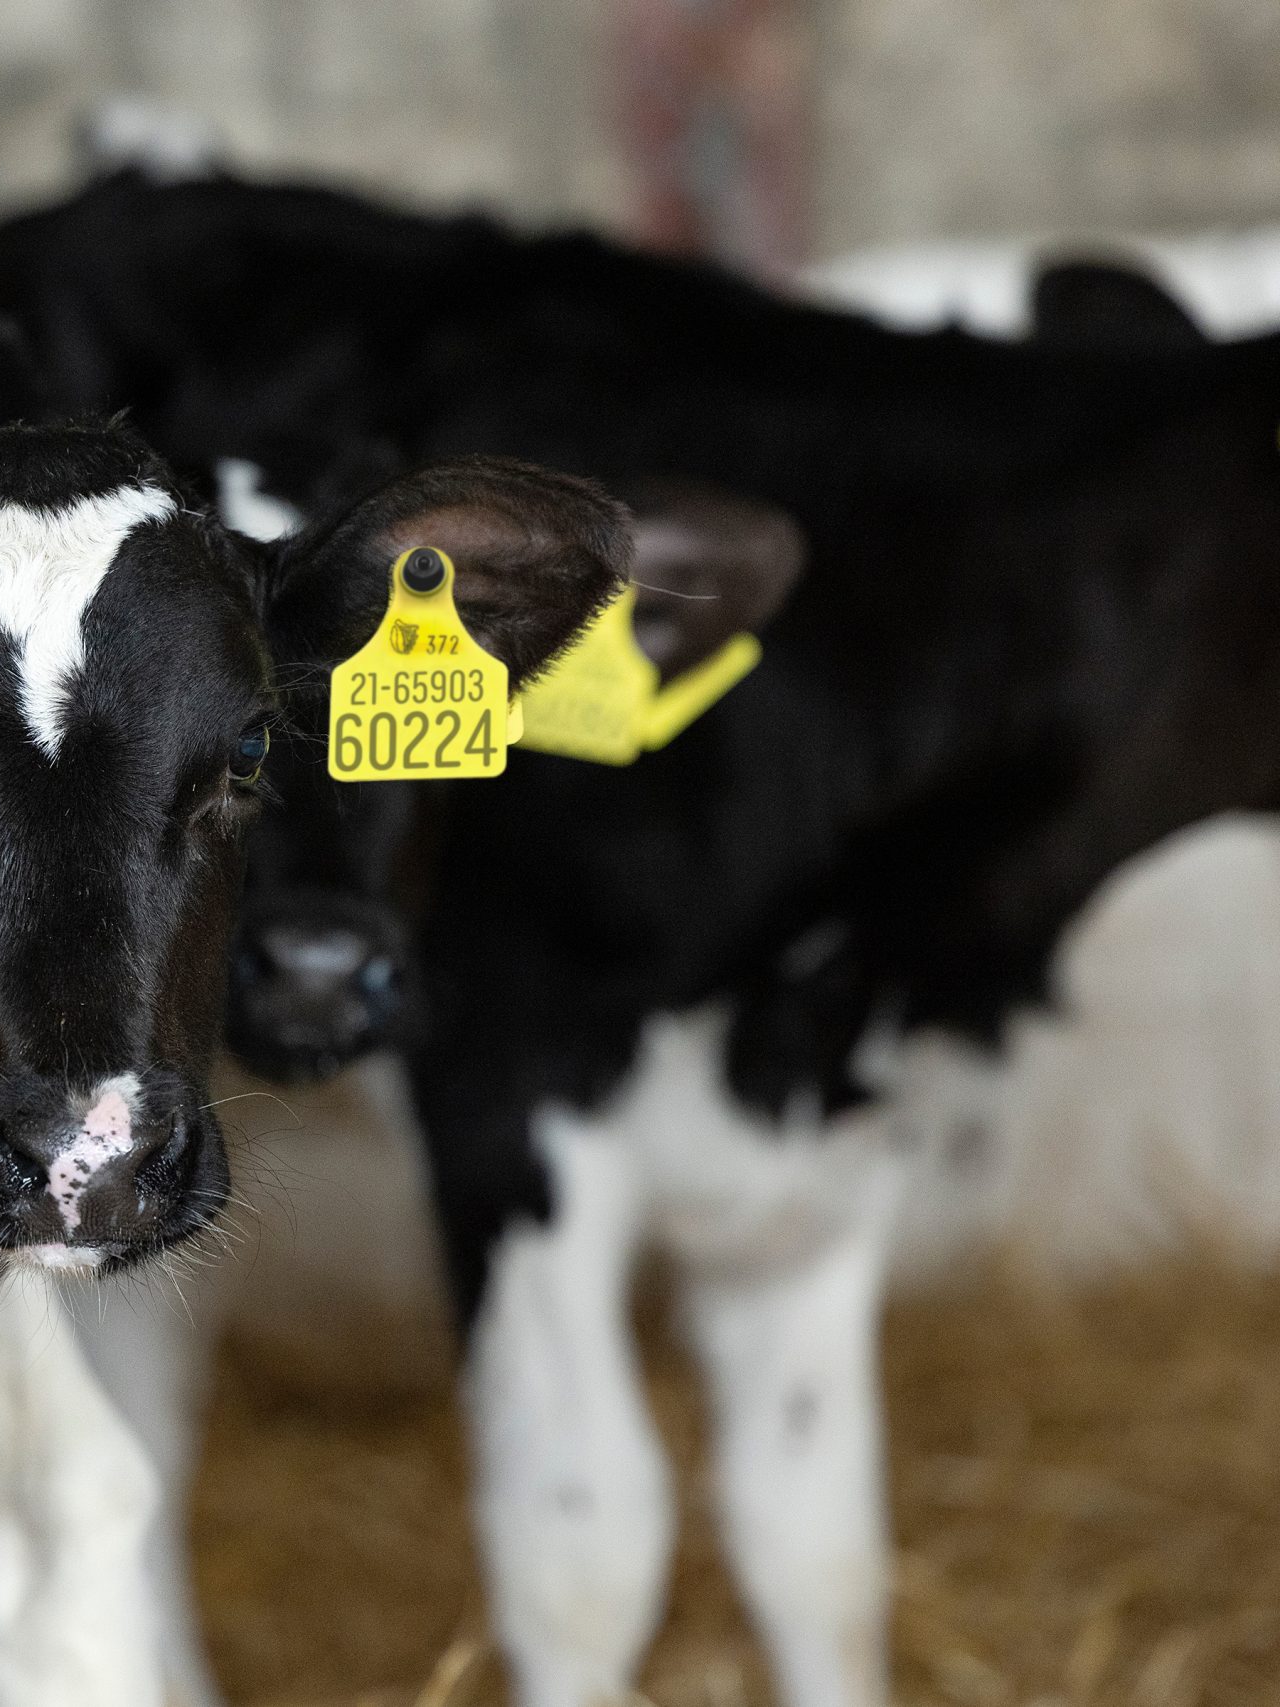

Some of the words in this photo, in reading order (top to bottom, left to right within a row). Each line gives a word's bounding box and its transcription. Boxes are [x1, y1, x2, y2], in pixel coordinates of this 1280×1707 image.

[426, 634, 459, 655] 372
[350, 669, 484, 706] 21-65903
[334, 708, 498, 773] 60224
